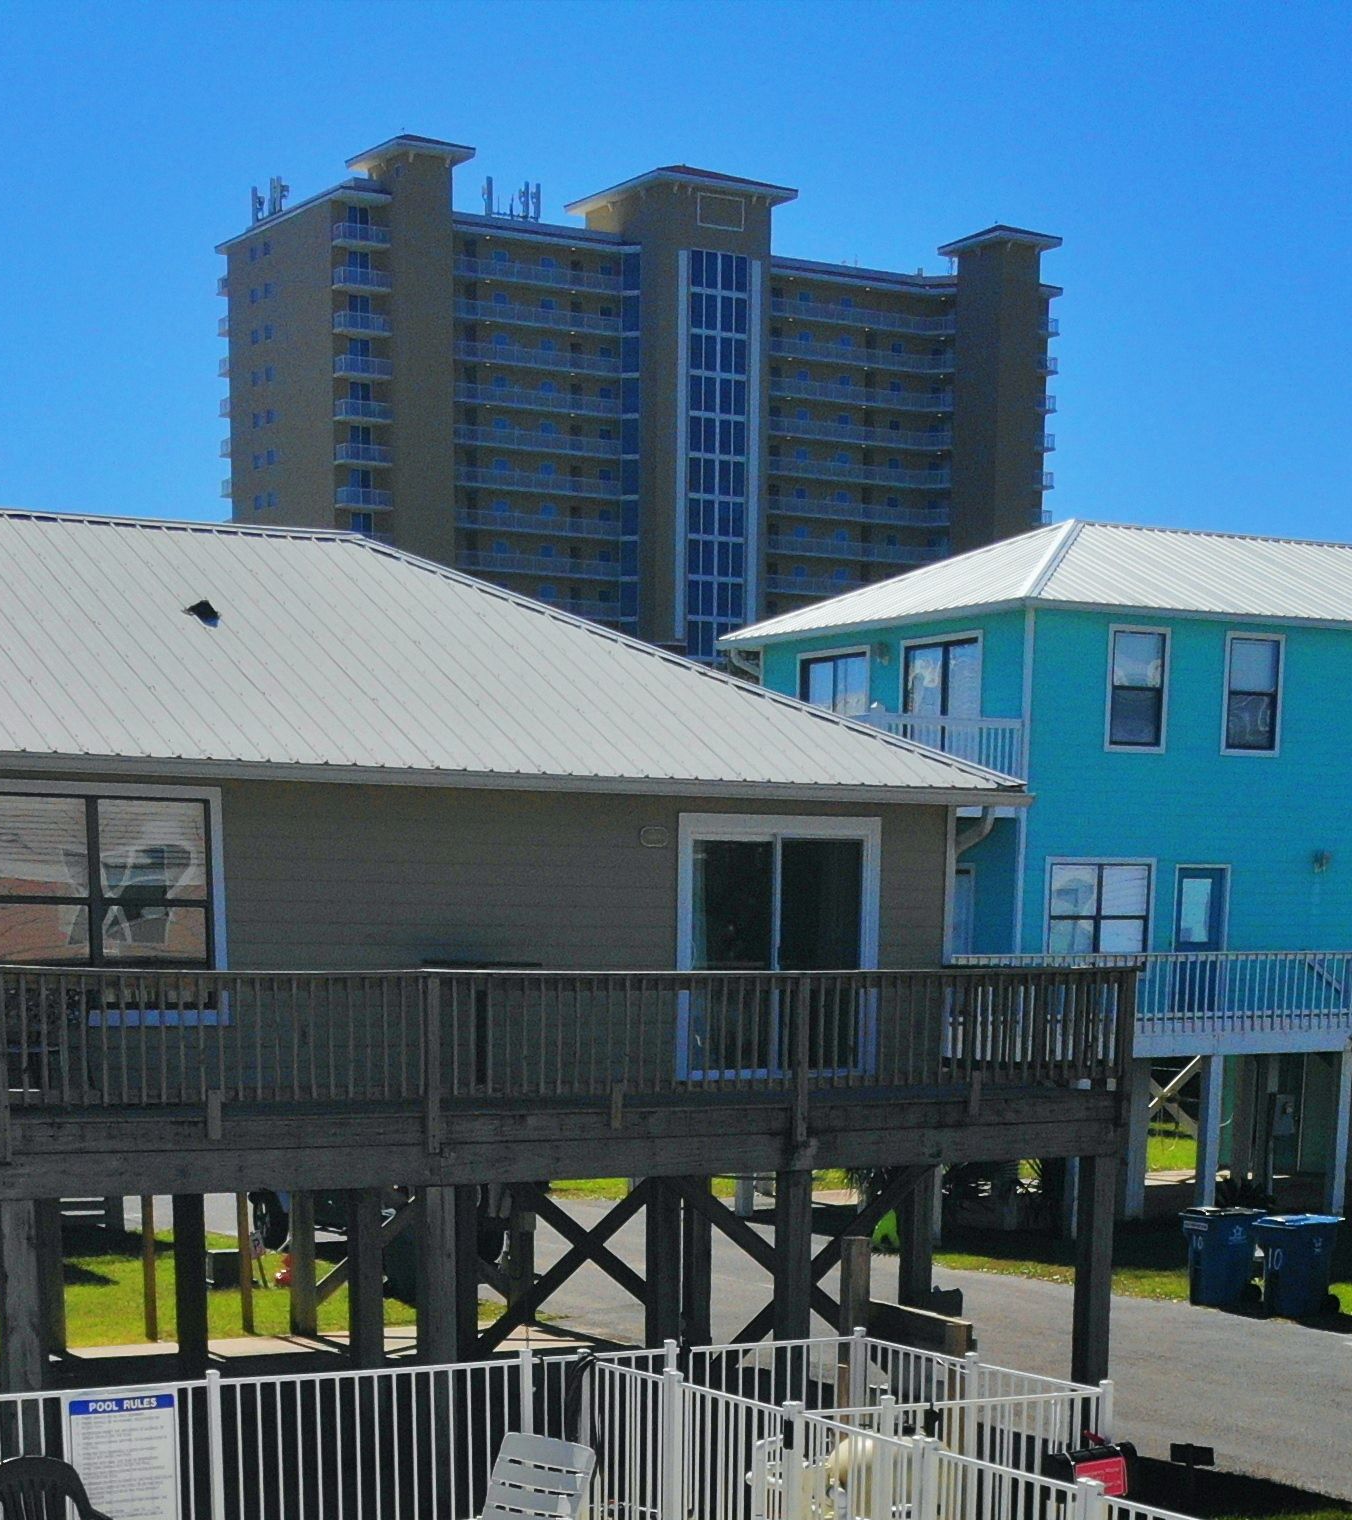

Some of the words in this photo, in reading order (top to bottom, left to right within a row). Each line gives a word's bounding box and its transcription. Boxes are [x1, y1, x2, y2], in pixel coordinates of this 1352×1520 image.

[1268, 1248, 1284, 1270] 10
[88, 1401, 119, 1413] POOL
[123, 1397, 158, 1410] RULES
